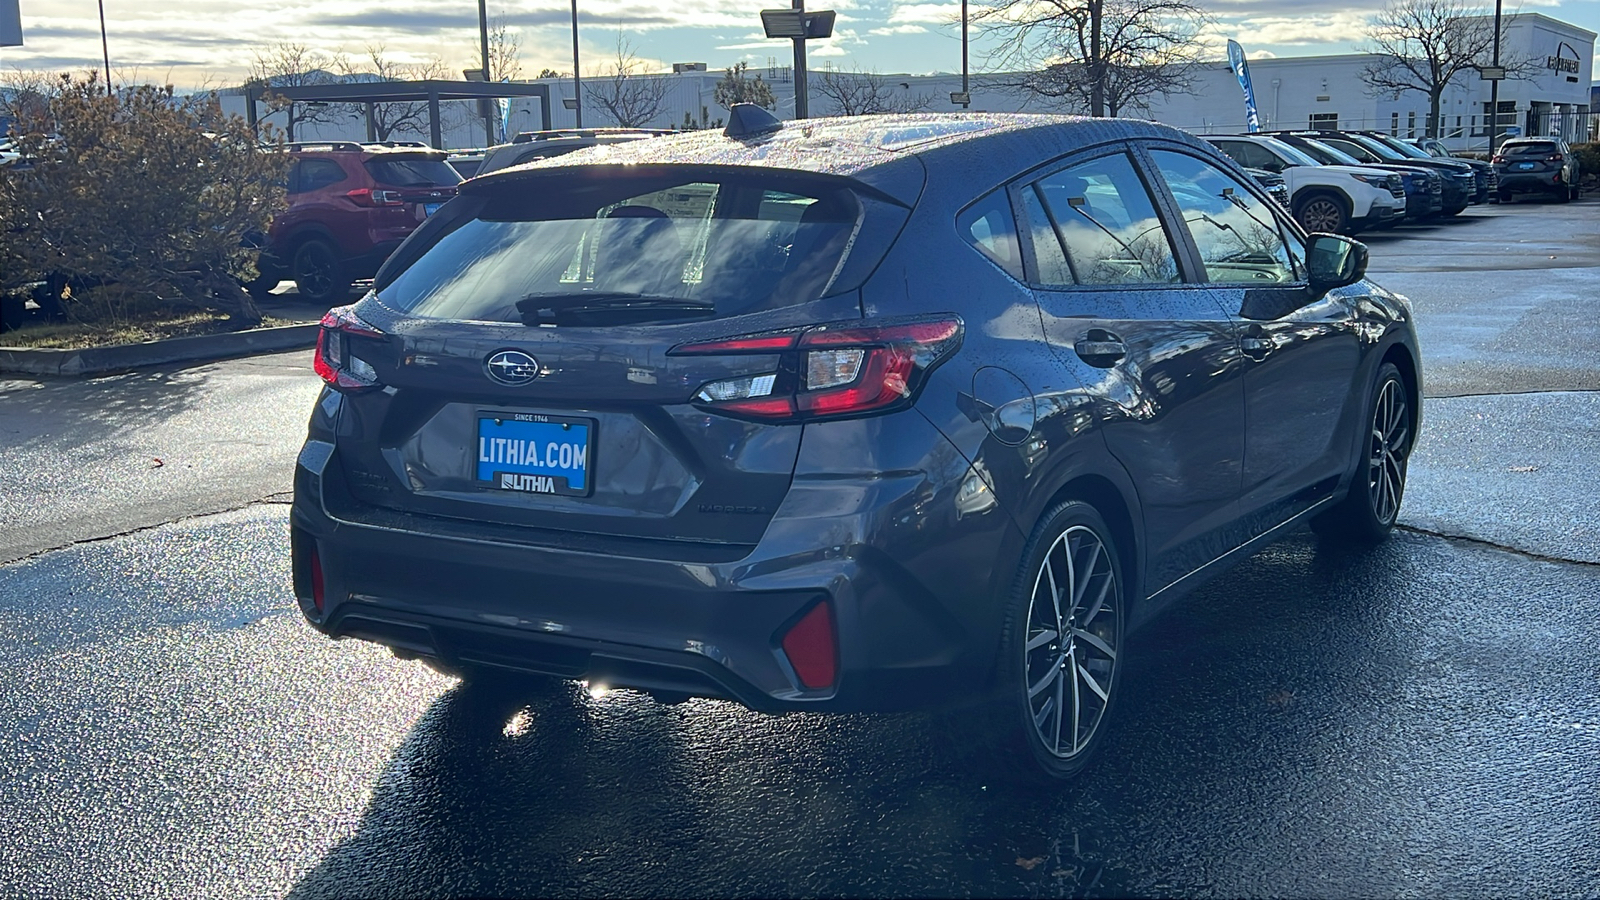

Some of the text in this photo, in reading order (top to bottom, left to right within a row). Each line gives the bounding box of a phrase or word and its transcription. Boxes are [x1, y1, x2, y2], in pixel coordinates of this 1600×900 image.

[514, 413, 549, 423] SINCE 1946
[479, 436, 587, 471] LITHIA.COM
[513, 474, 555, 493] LITHIA
